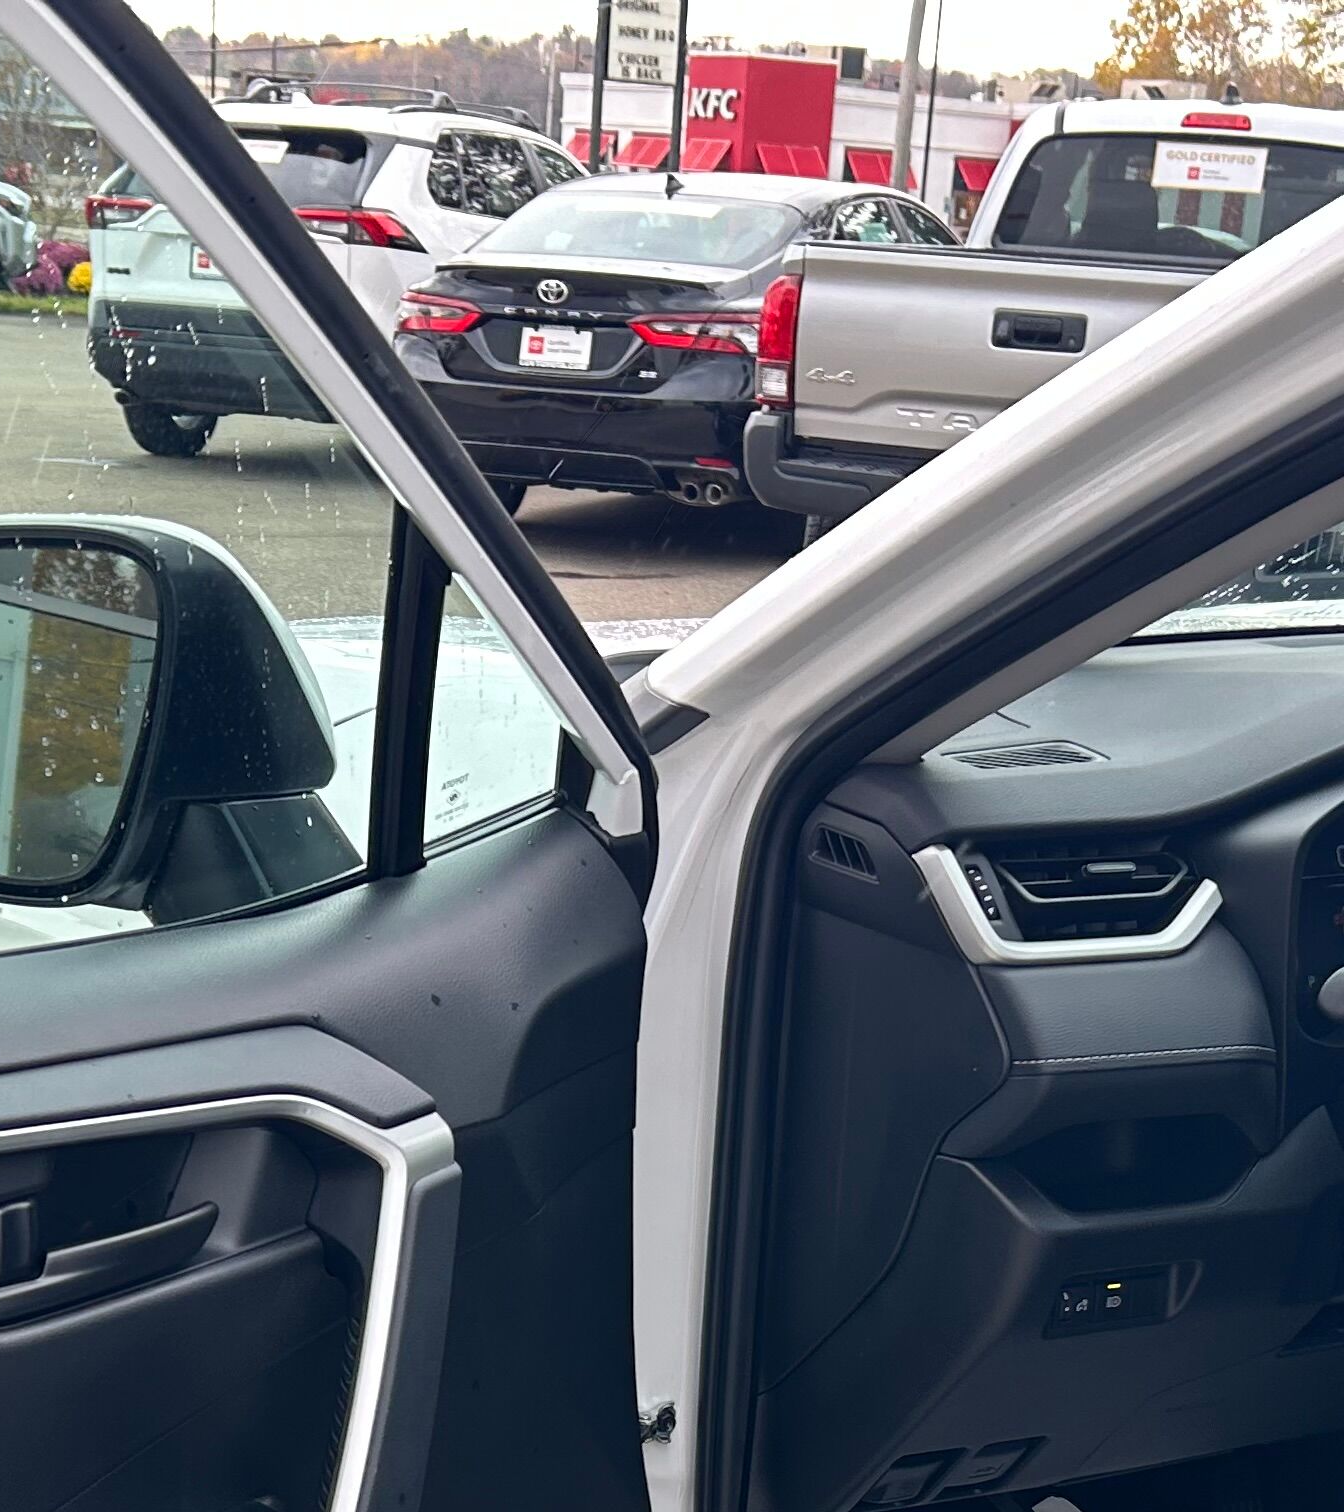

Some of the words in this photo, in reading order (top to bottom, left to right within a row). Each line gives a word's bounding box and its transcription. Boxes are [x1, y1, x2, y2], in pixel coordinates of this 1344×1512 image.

[687, 87, 739, 121] KFC
[1166, 149, 1198, 162] GOLD
[1199, 151, 1256, 165] CERTIFIED
